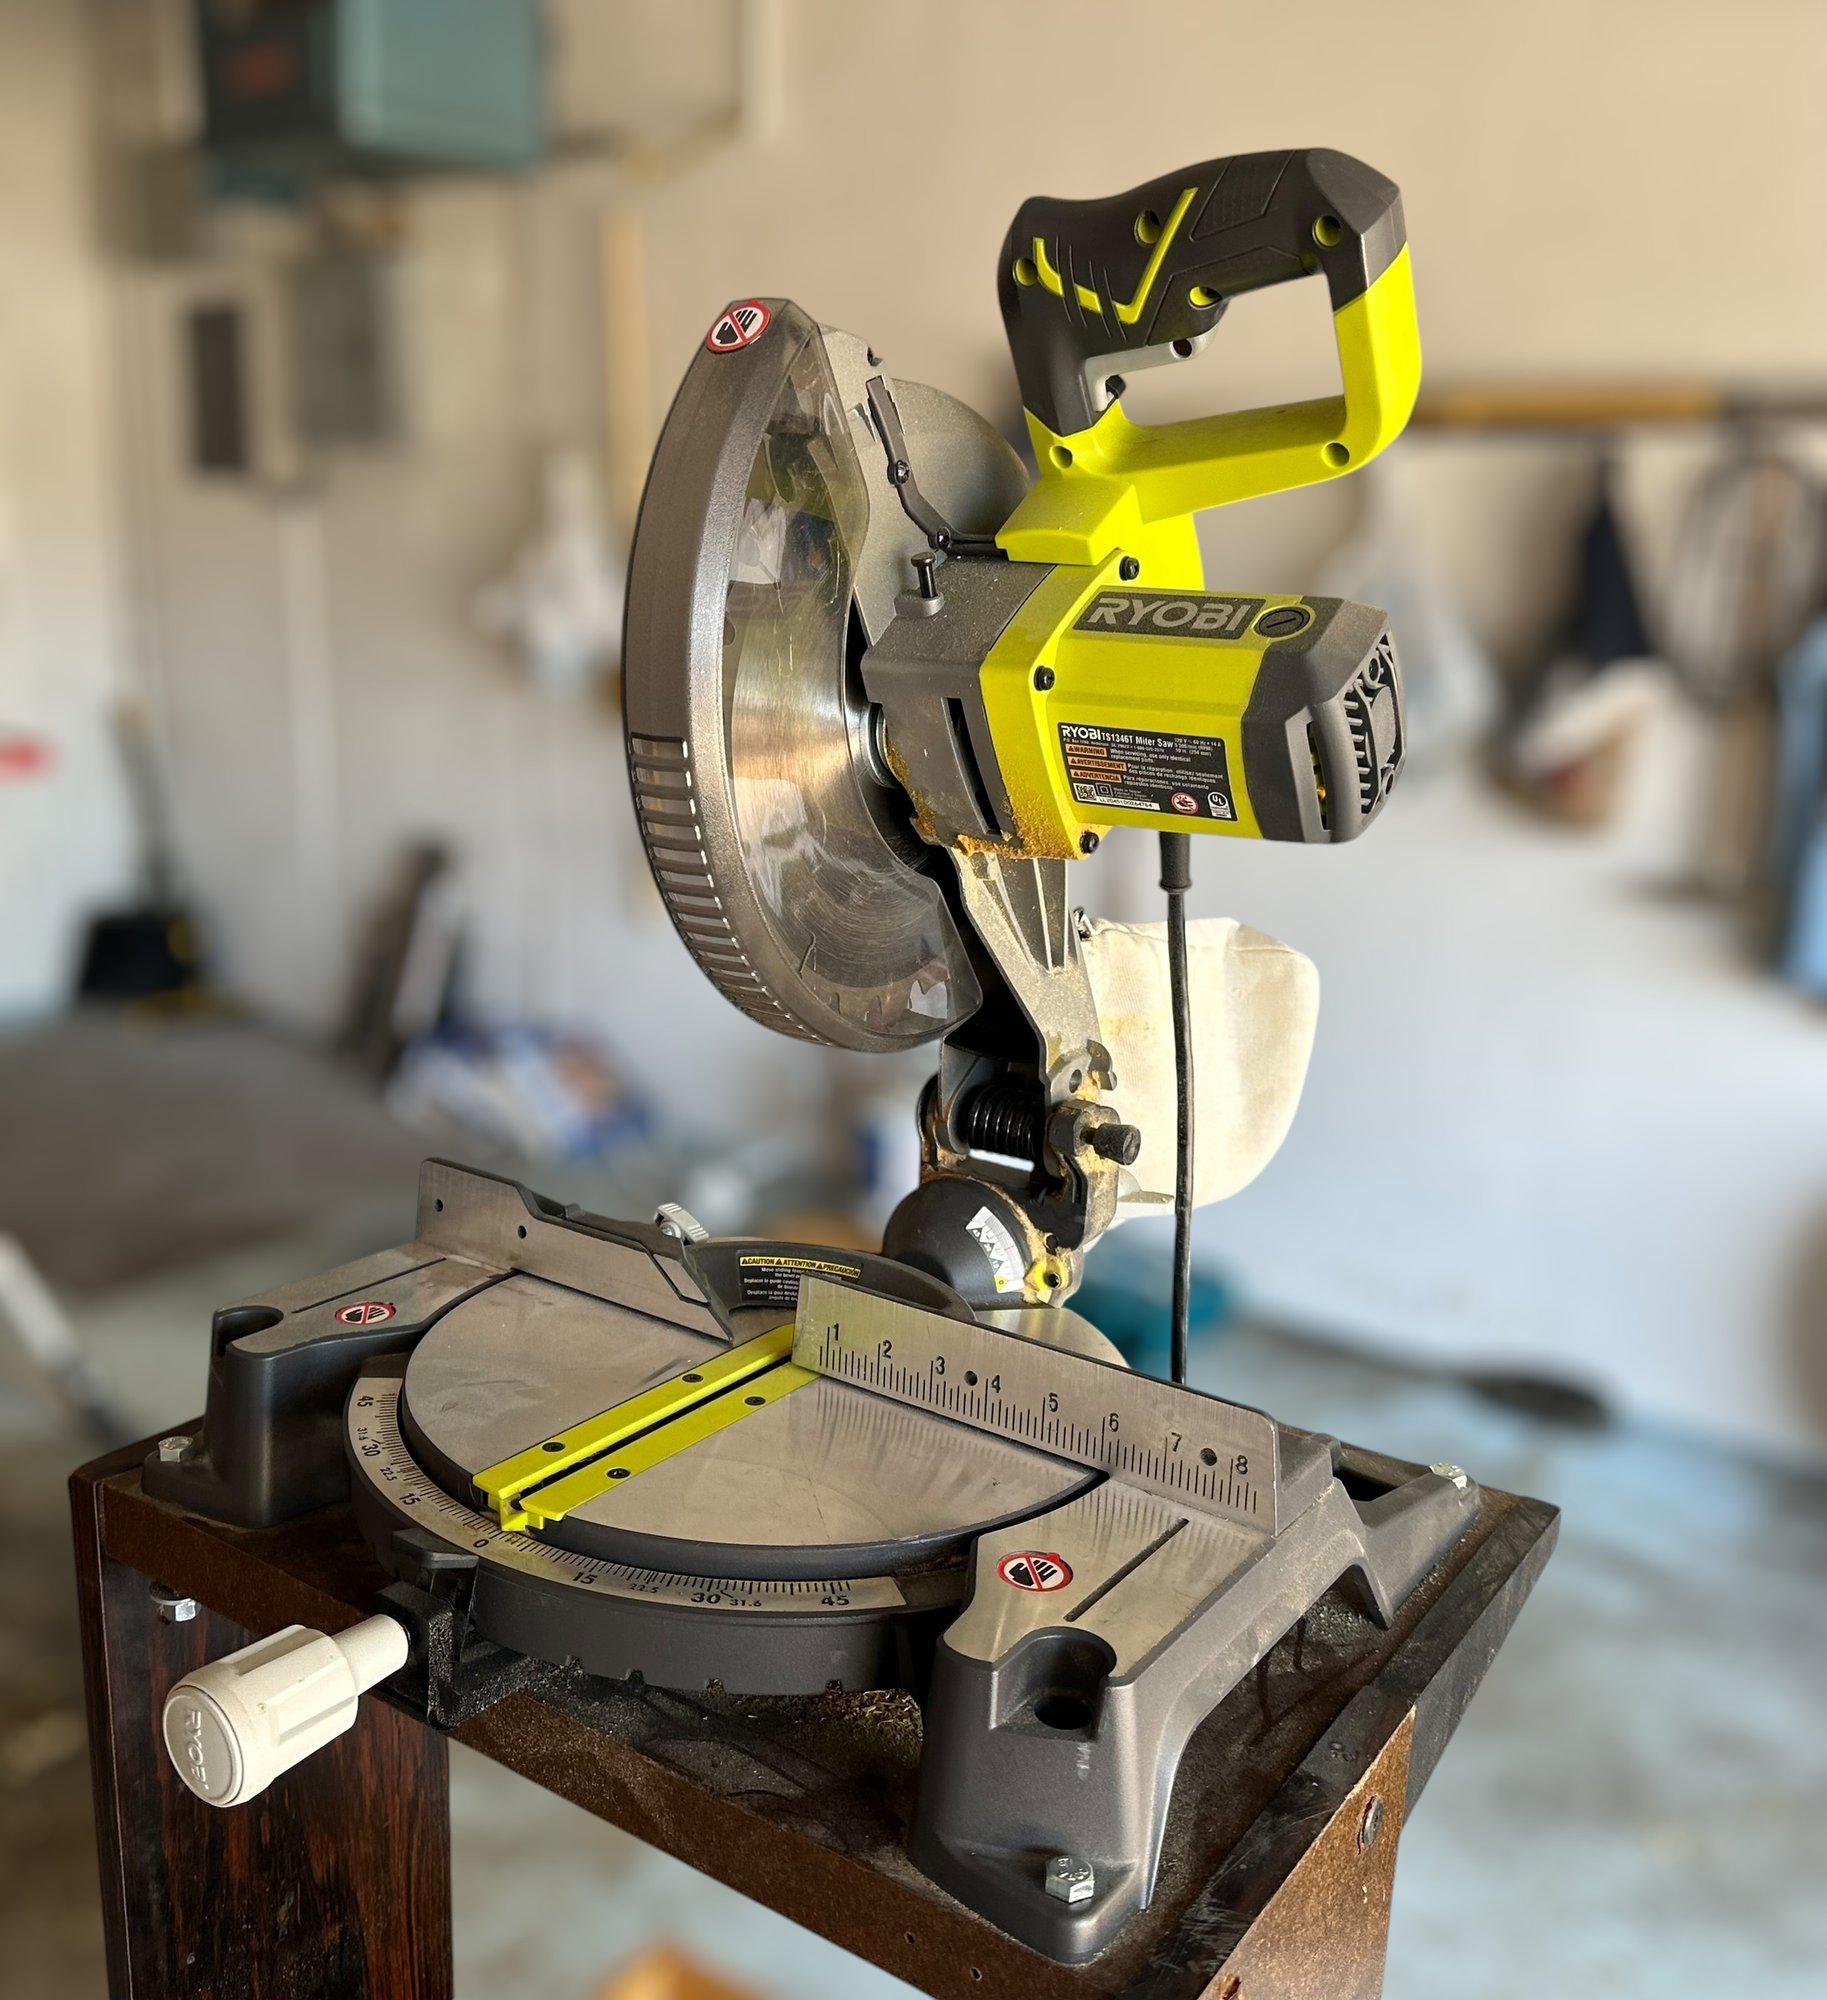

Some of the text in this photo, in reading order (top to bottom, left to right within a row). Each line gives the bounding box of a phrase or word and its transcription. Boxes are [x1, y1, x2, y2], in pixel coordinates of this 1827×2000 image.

[1087, 597, 1250, 631] RYOBI
[1061, 725, 1101, 740] RYOBI
[1101, 732, 1133, 744] TS1346T
[1135, 735, 1155, 746] Miter
[1157, 738, 1174, 748] Saw
[1074, 746, 1105, 755] WARNING
[1077, 758, 1124, 769] AVERTISSEMENT
[1080, 771, 1119, 781] ADVERTENCIA
[1212, 795, 1224, 805] UL
[783, 1259, 816, 1269] ATTENTION
[357, 1395, 374, 1407] 45
[832, 1323, 1248, 1475] 1 2 3 4 5 6 7 8
[361, 1443, 381, 1457] 30
[380, 1466, 398, 1482] 22.5
[399, 1492, 422, 1506] 15
[473, 1538, 489, 1549] 0
[572, 1571, 850, 1607] 15 22.5 30 31.6 45
[184, 1711, 209, 1790] RYOBI
